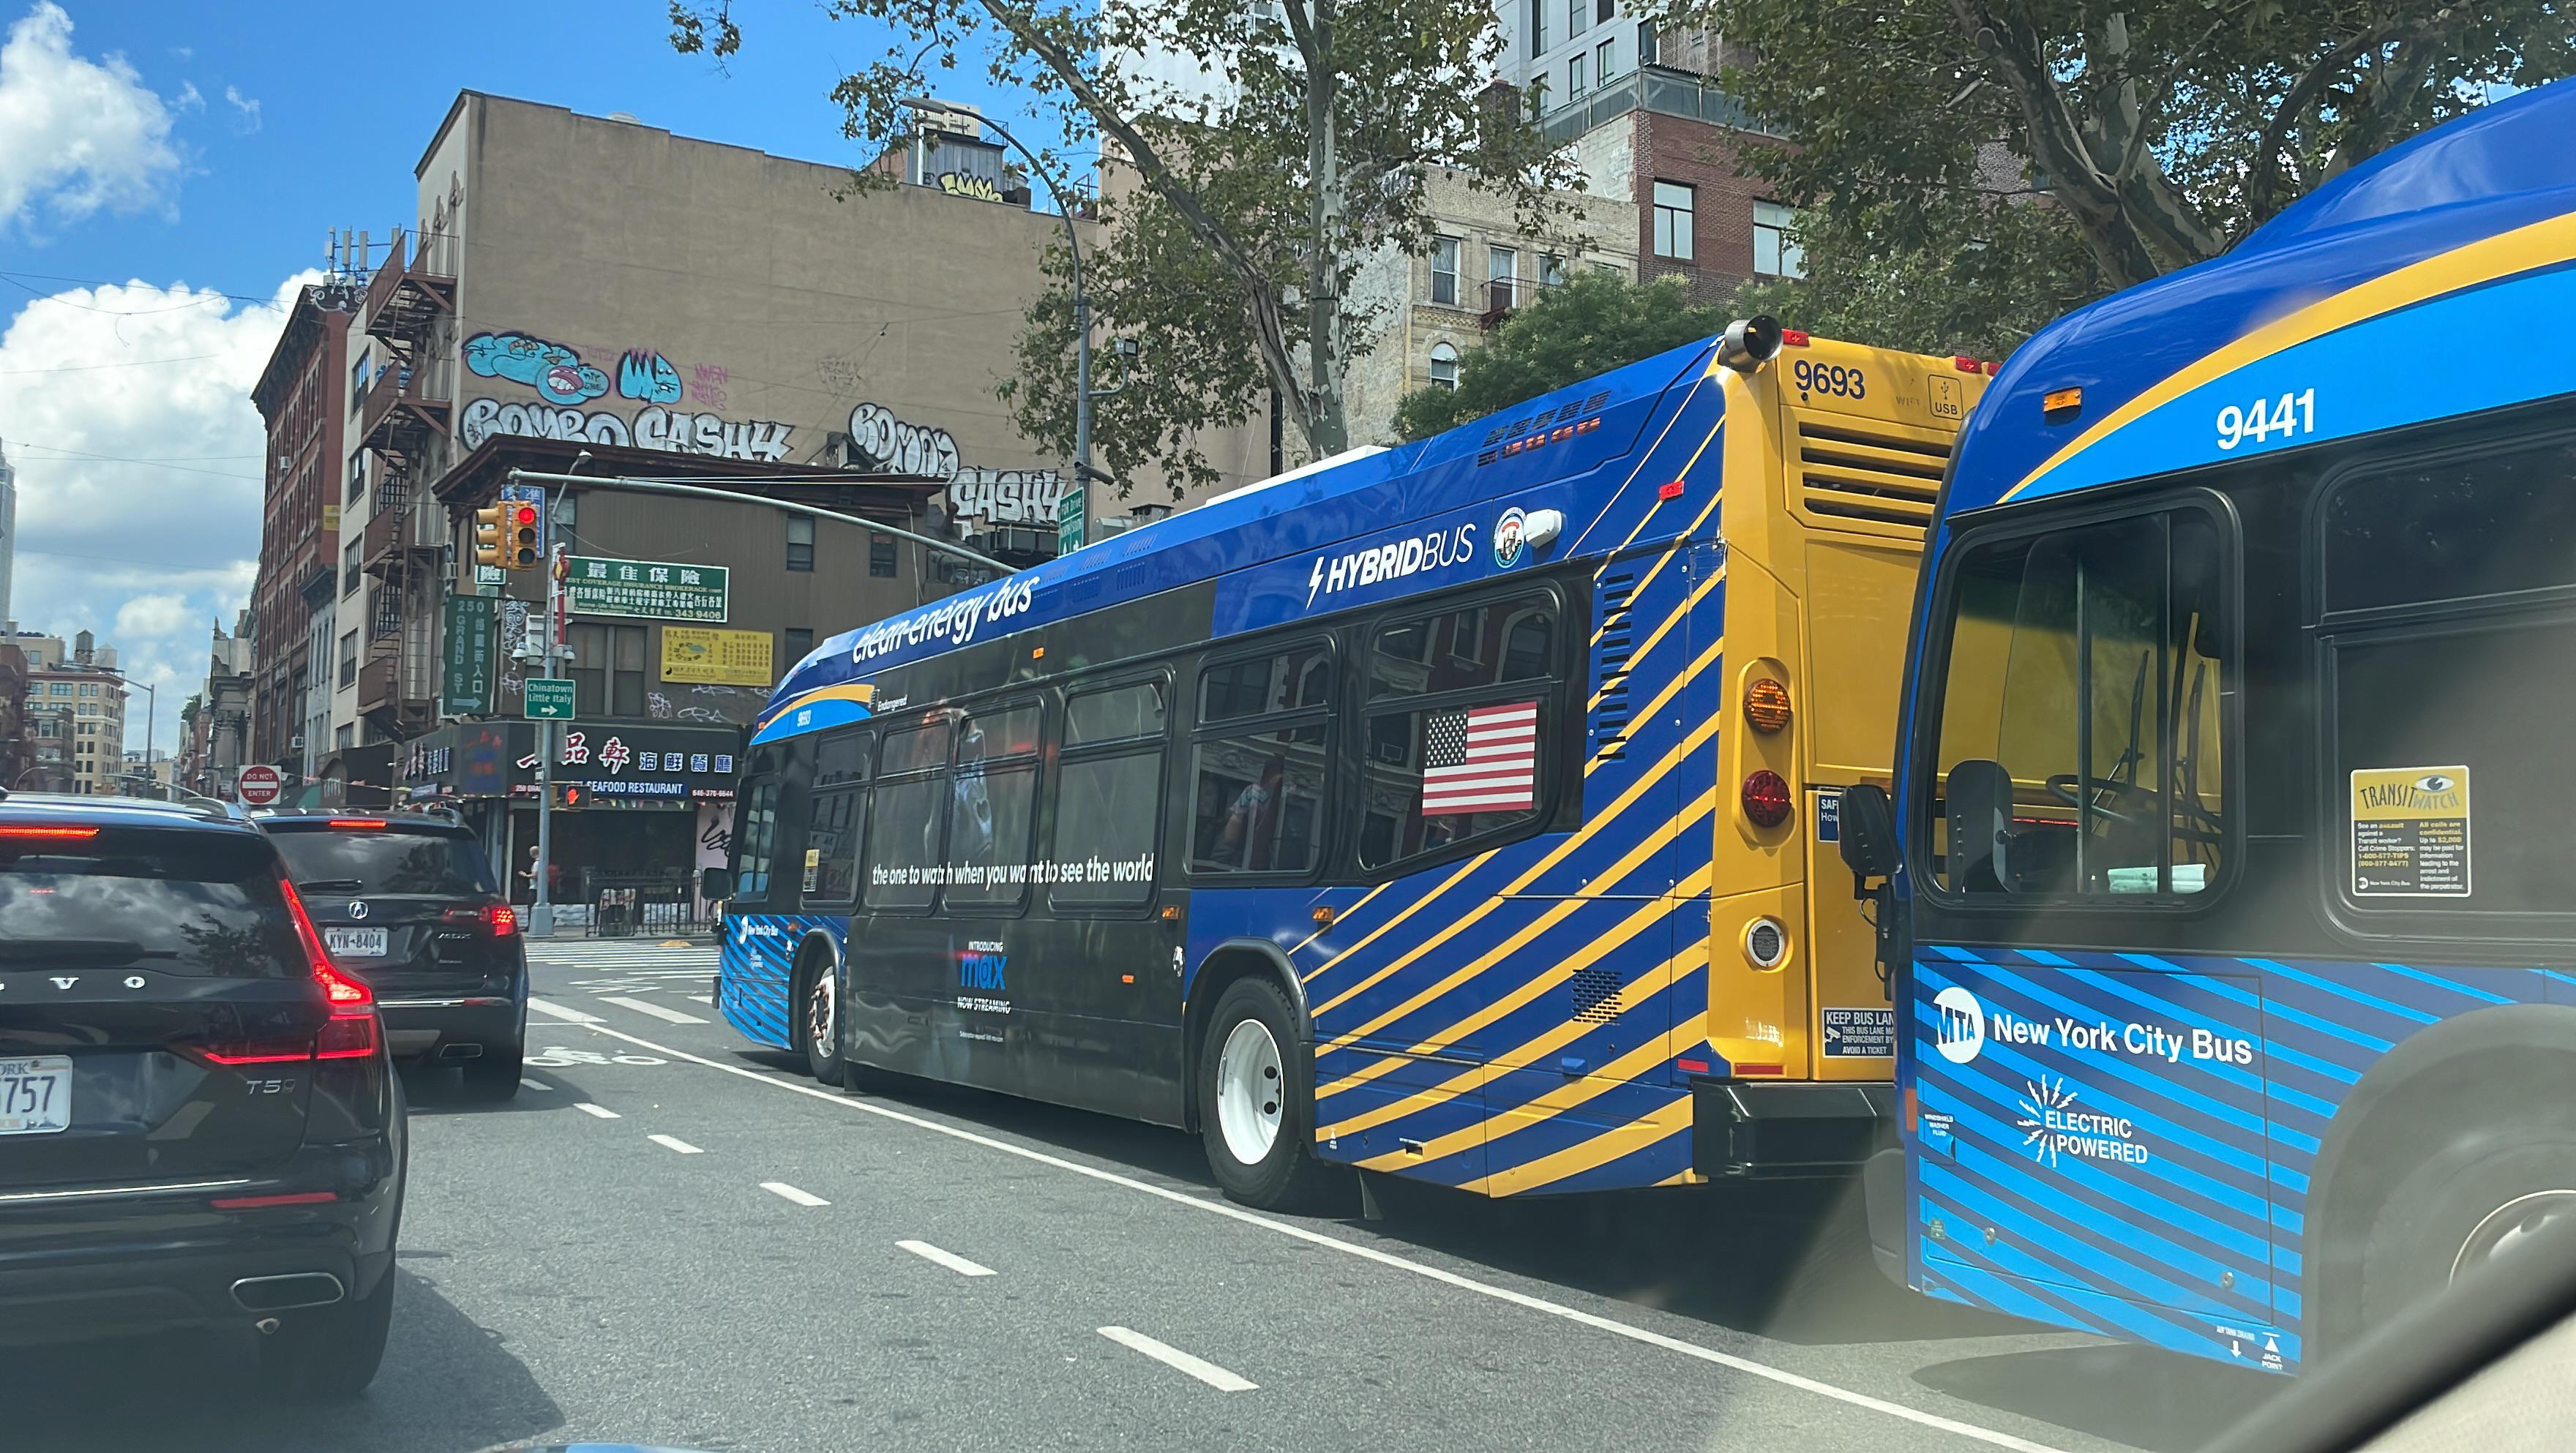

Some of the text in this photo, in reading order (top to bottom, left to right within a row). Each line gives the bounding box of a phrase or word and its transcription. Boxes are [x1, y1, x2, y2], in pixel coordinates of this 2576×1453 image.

[1794, 359, 1865, 399] 9693
[1935, 402, 1958, 415] USB
[2216, 388, 2314, 450] 9441
[587, 562, 701, 585] 最佳保險
[582, 579, 621, 587] COVERAGE
[623, 581, 664, 590] INSURANCE
[457, 600, 484, 613] 250
[853, 574, 1040, 664] clean-energy bus
[454, 615, 466, 694] GRAND ST
[528, 683, 573, 694] Chinatown
[528, 694, 572, 705] Little Italy
[586, 781, 683, 795] SEAFOOD RESTAURANT
[2360, 783, 2459, 810] TRANSIT WATCH
[1821, 799, 1839, 810] SAF
[872, 864, 888, 886] the
[889, 866, 907, 886] one
[908, 863, 920, 885] to
[954, 860, 985, 884] when
[986, 863, 1007, 891] you
[1009, 860, 1044, 884] want
[1060, 862, 1085, 882] see
[1086, 855, 1111, 883] the
[1112, 852, 1155, 882] world
[967, 940, 1003, 953] INTRODUCING
[961, 953, 1008, 991] max
[957, 996, 1011, 1014] NOW STREAMING
[1826, 1011, 1852, 1024] KEEP
[1853, 1011, 1874, 1025] BUS
[1842, 1026, 1856, 1035] THIS
[1857, 1026, 1868, 1035] BUS
[1869, 1026, 1884, 1035] LANE
[1935, 1002, 2253, 1065] MTA New York City Bus
[1842, 1035, 1893, 1044] ENFORCEMENT BY
[1842, 1046, 1887, 1054] AVOID A TICKET
[0, 1075, 56, 1114] 757
[2045, 1109, 2133, 1138] ELECTRIC
[2056, 1133, 2148, 1164] POWERED
[2261, 1359, 2283, 1370] POINT
[2262, 1353, 2282, 1363] JACK
